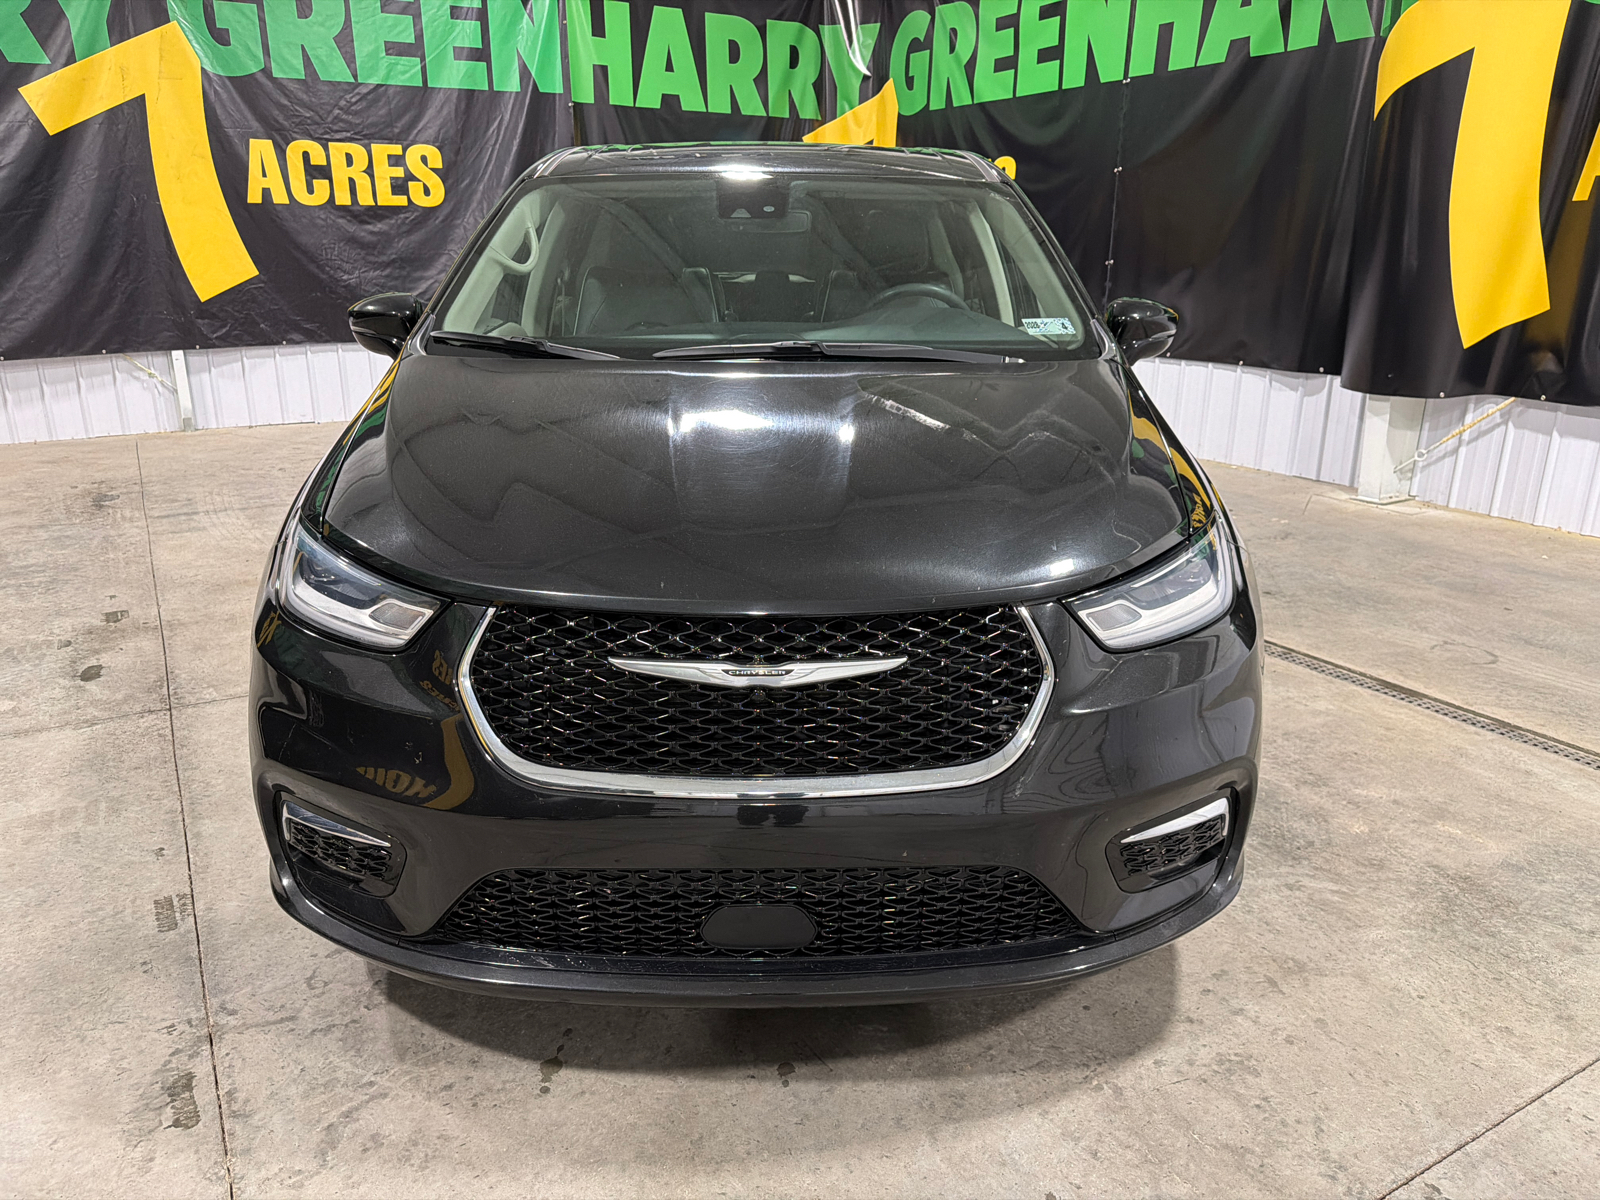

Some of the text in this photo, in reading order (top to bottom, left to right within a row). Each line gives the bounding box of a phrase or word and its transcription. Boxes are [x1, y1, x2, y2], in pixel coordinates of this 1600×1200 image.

[167, 0, 563, 94] GREEN
[570, 0, 881, 120] HARRY
[890, 0, 1128, 117] GREEN
[18, 20, 446, 302] 7 ACRES
